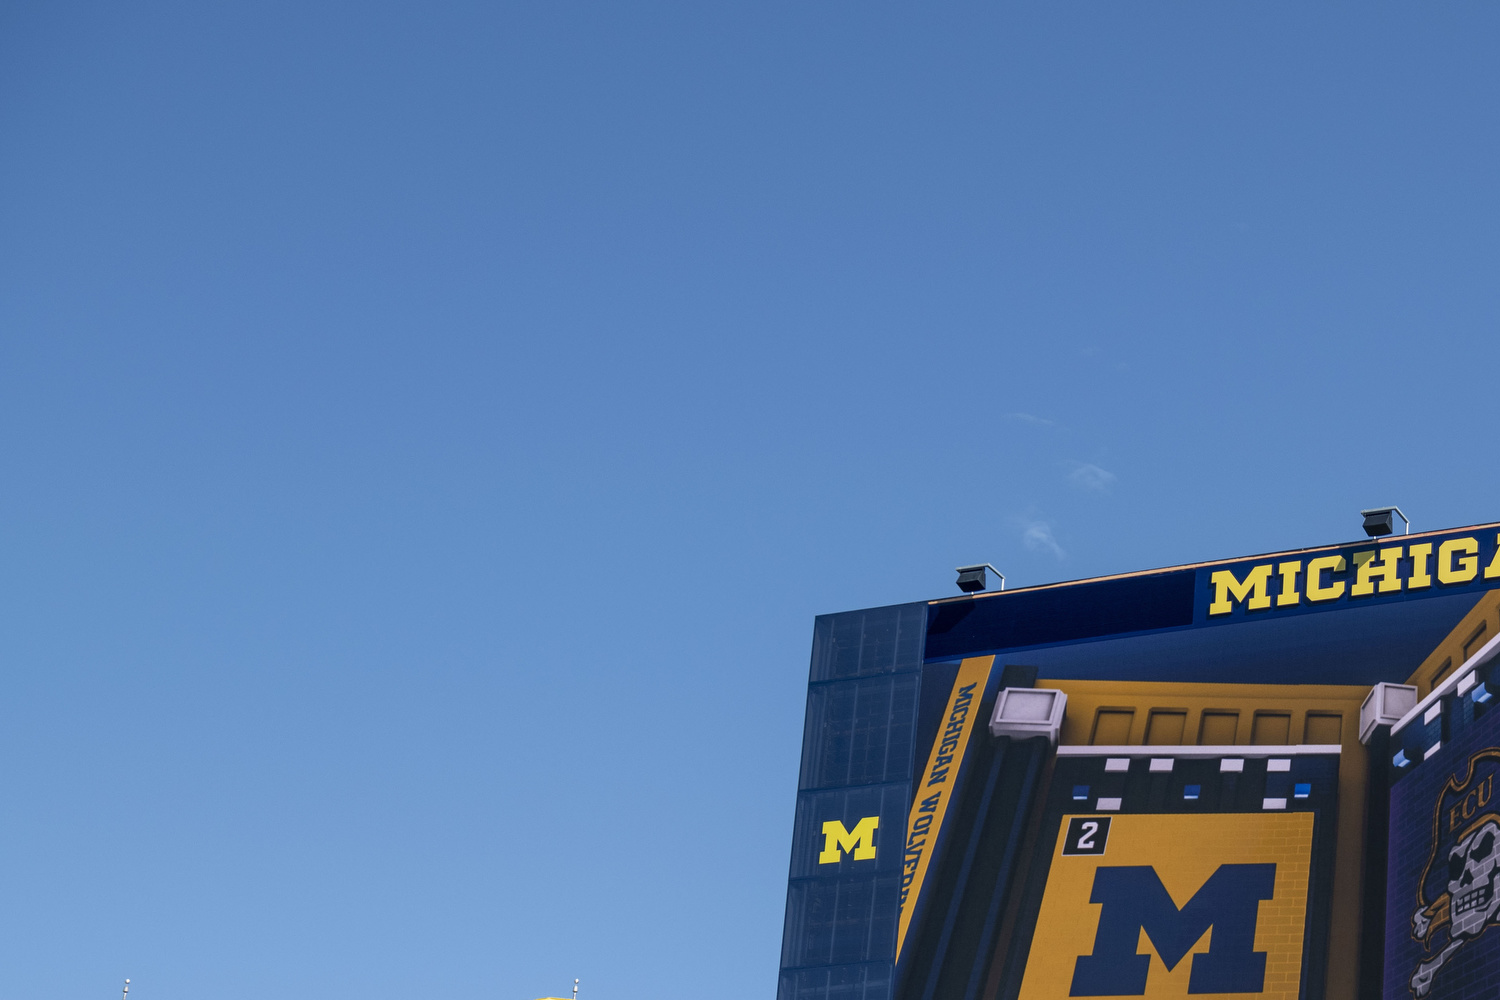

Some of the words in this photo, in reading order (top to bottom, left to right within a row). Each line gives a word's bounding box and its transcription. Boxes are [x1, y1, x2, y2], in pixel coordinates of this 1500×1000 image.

[927, 682, 977, 788] MICHIGAN
[1447, 773, 1495, 833] ECU
[818, 816, 879, 865] M
[1076, 822, 1099, 850] 2
[1069, 863, 1277, 997] M
